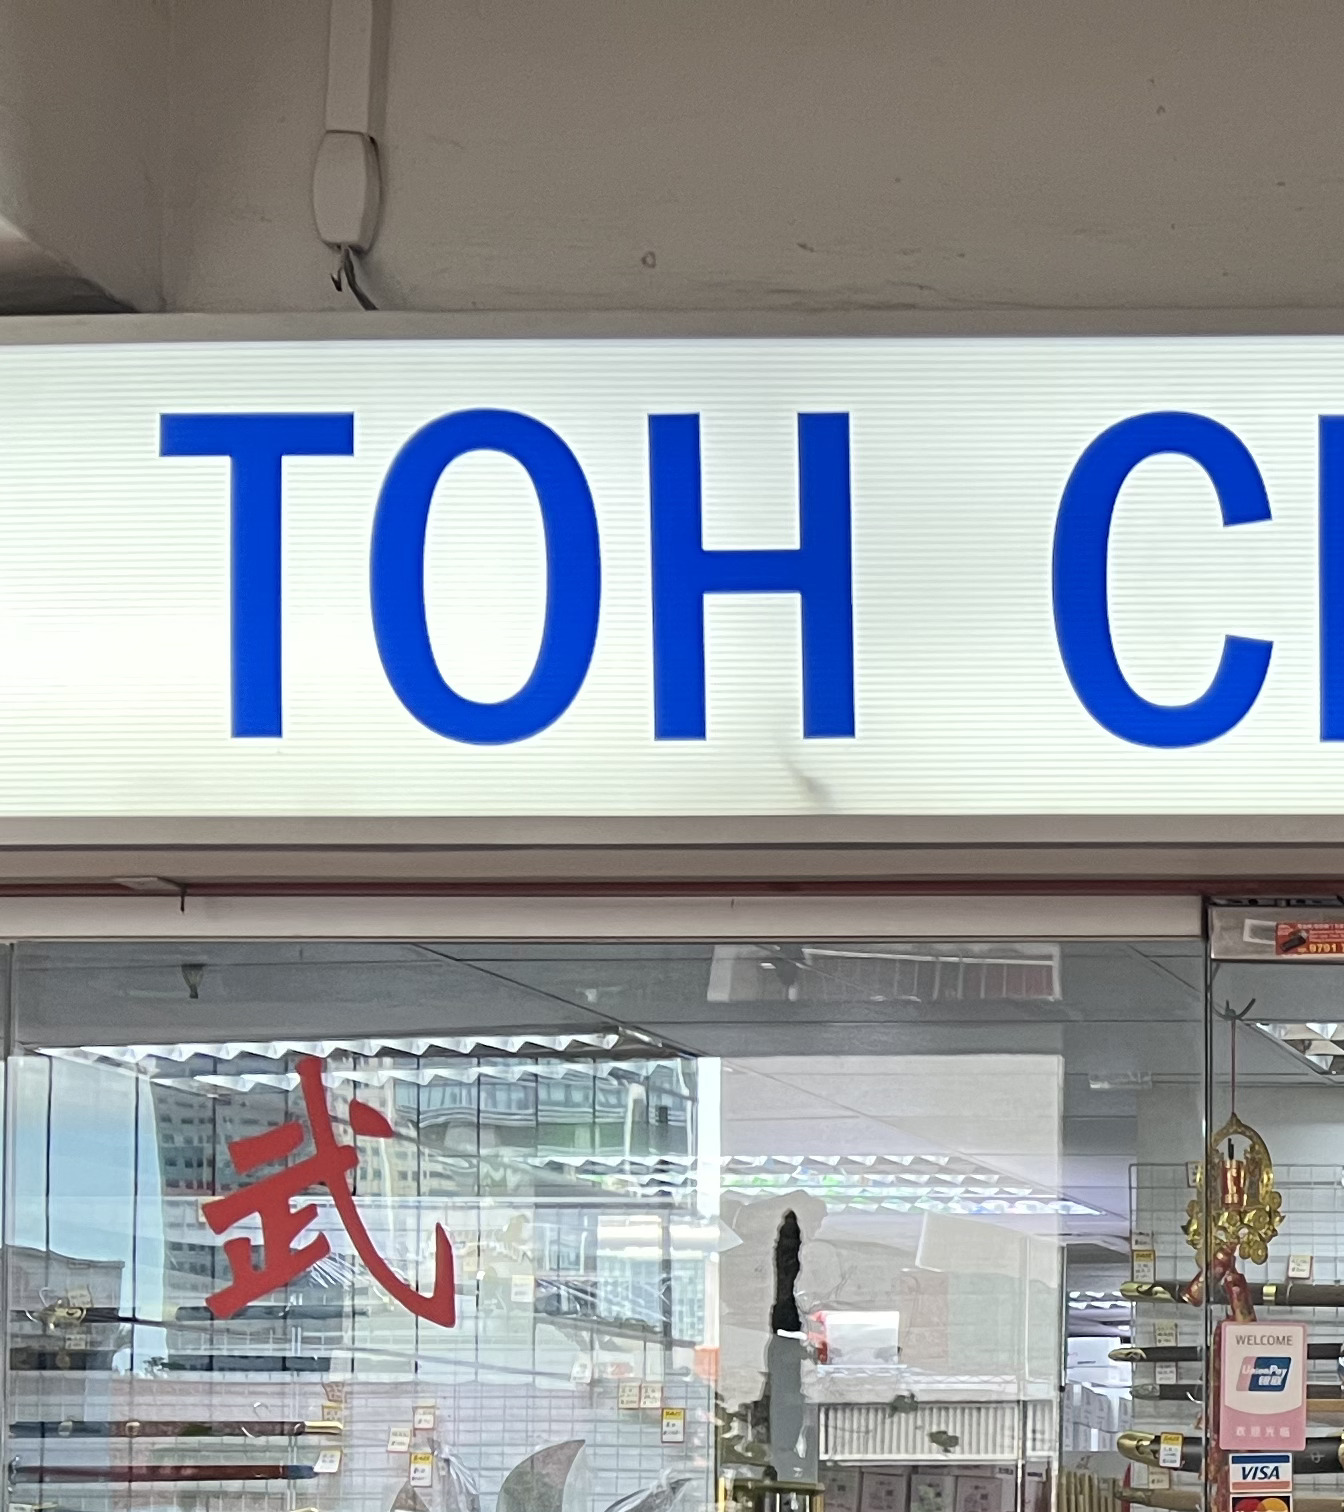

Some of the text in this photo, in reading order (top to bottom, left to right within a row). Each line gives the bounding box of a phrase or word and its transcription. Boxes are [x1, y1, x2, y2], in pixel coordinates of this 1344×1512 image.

[162, 410, 854, 744] TOH
[204, 1055, 455, 1326] 武
[1235, 1334, 1293, 1346] WELCOME
[1241, 1364, 1288, 1379] UnionPay
[1240, 1465, 1280, 1480] VISA
